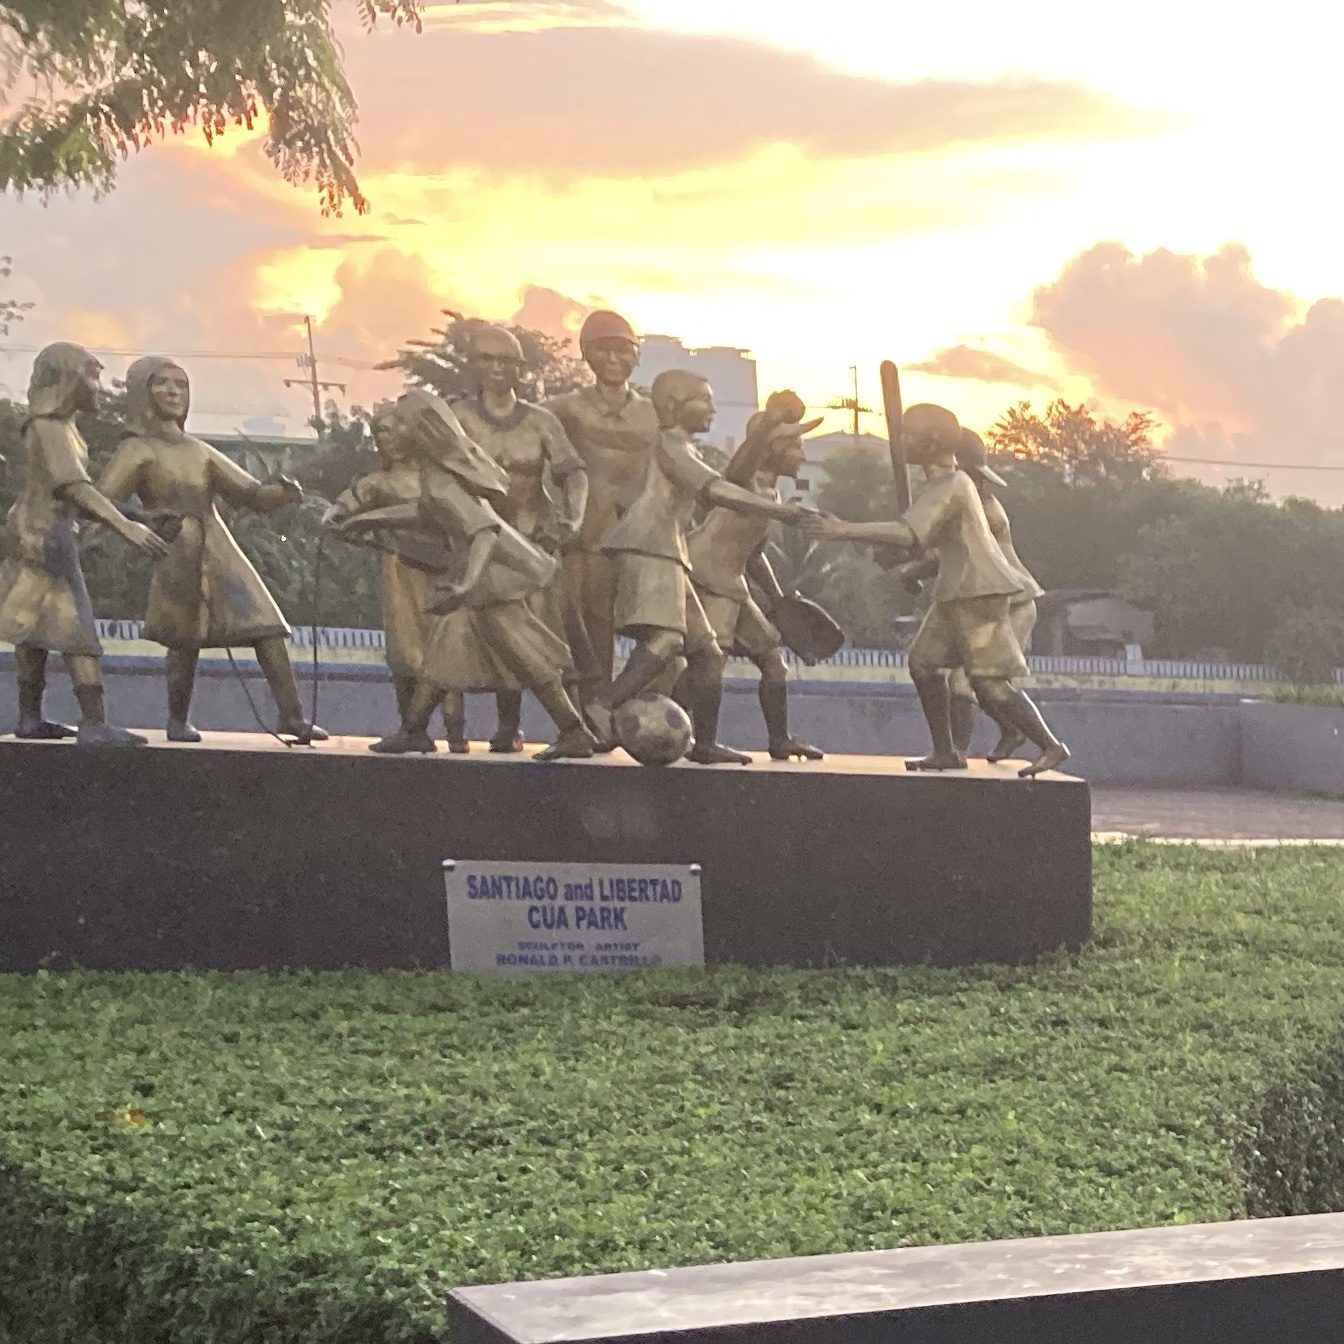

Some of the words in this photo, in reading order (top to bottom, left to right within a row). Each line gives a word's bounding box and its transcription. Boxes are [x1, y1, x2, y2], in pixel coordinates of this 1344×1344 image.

[466, 874, 558, 900] SANTIAGO
[564, 879, 593, 900] and
[598, 878, 682, 903] LIBERTAD
[527, 905, 569, 930] CUA
[575, 905, 627, 930] PARK
